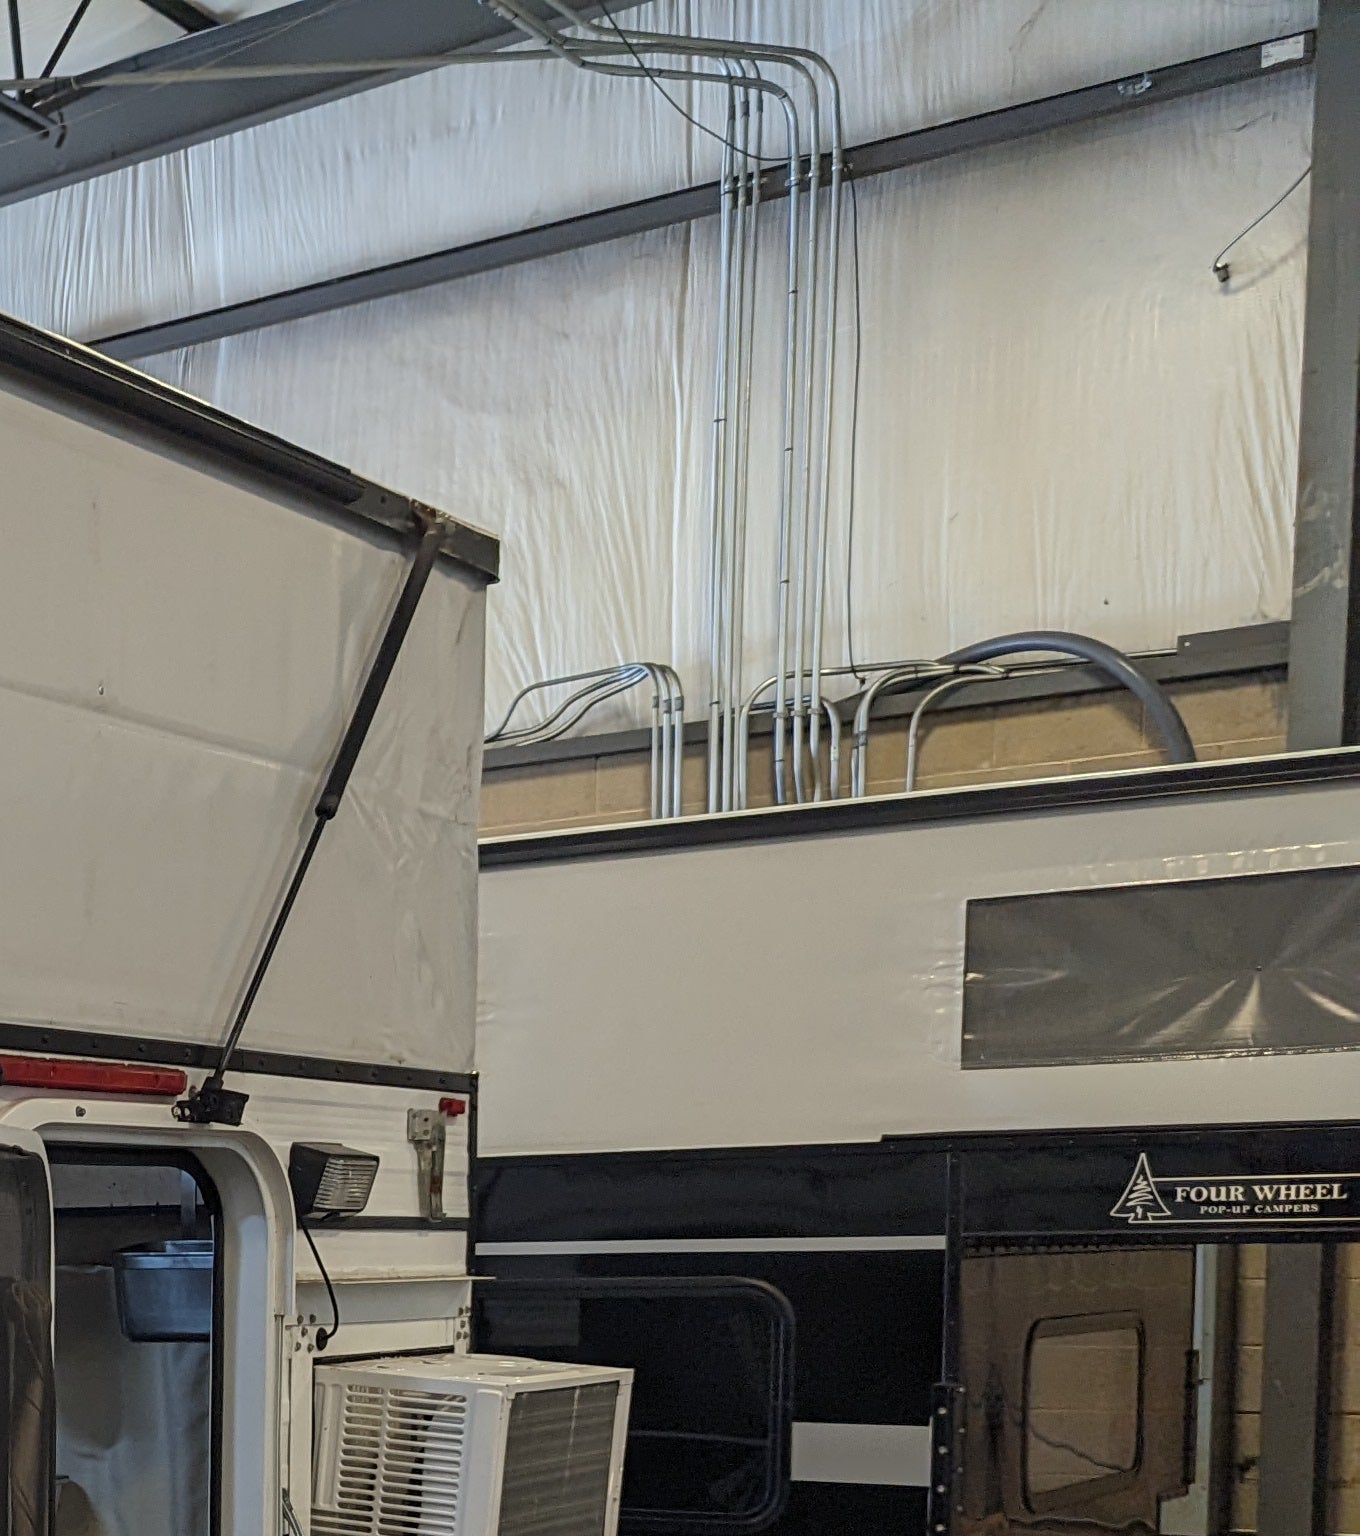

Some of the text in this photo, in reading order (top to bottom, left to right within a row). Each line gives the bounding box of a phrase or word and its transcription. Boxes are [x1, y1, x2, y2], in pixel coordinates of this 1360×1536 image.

[1174, 1183, 1348, 1203] FOUR WHEEL
[1199, 1202, 1320, 1215] POP-UP CAMPERS
